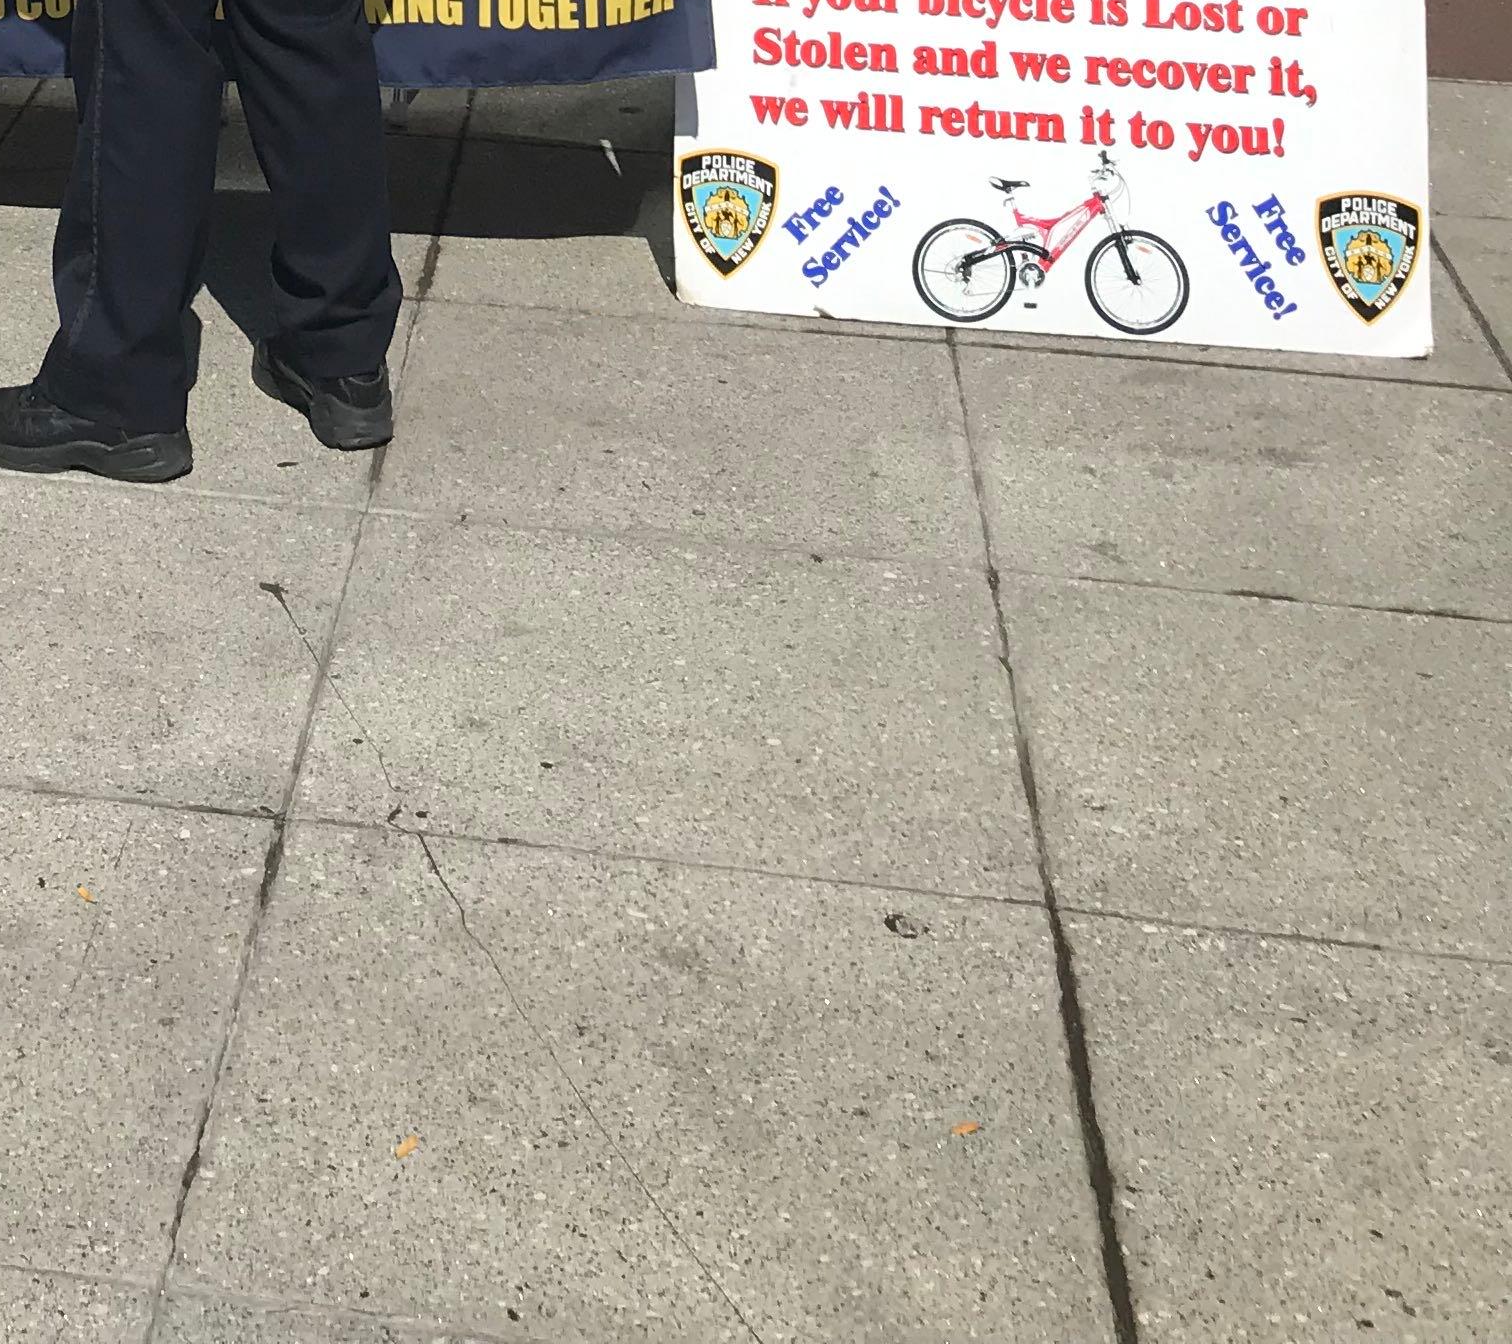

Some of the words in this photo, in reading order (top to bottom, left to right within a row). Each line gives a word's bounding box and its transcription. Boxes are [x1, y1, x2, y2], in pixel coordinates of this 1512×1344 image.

[1256, 5, 1308, 37] or
[753, 26, 899, 73] Stolen
[912, 40, 999, 79] and
[1009, 51, 1071, 83] we
[1084, 55, 1256, 94] recover
[1268, 56, 1317, 108] it,
[749, 94, 809, 127] we
[819, 91, 905, 133] will
[918, 101, 1067, 143] return
[1080, 105, 1116, 147] it
[1128, 111, 1174, 150] to
[1185, 117, 1285, 162] you!
[683, 169, 774, 197] DEPARTMENT
[701, 155, 756, 175] POLICE
[685, 201, 703, 234] CITY
[700, 239, 717, 255] OF
[730, 239, 755, 265] NEW
[752, 202, 773, 236] YORK
[781, 185, 845, 245] Free
[801, 185, 901, 289] Service!
[1251, 193, 1306, 267] Free
[1321, 211, 1417, 240] DEPARTMENT
[1341, 197, 1398, 216] POLICE
[1205, 200, 1298, 321] Service!
[1324, 246, 1345, 279] CITY
[1341, 283, 1359, 301] OF
[1373, 282, 1399, 310] NEW
[1394, 245, 1416, 281] YORK
